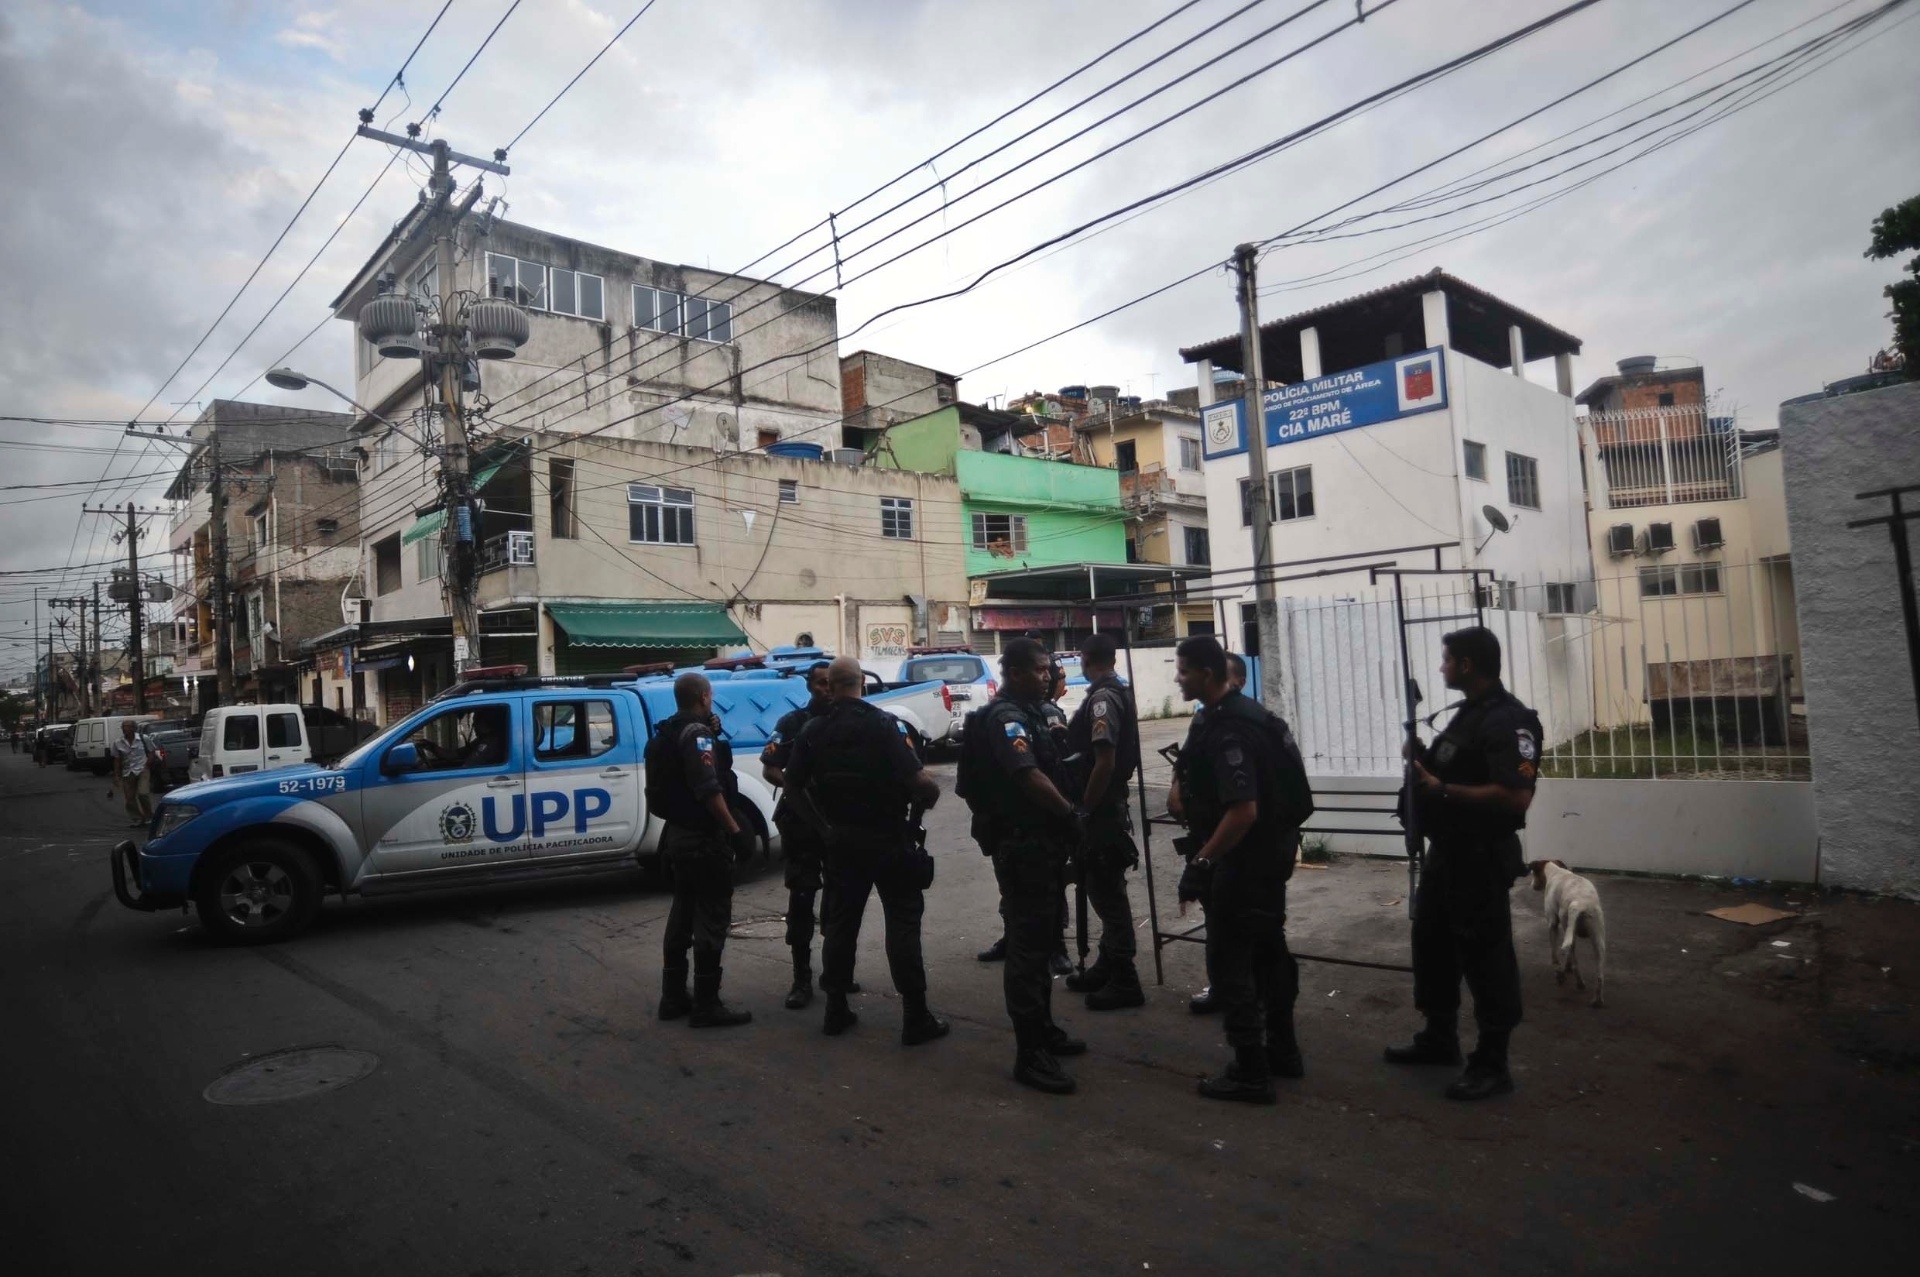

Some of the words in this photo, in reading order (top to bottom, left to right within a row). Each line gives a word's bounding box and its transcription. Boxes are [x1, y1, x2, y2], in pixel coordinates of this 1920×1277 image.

[1263, 385, 1309, 403] POLÍCIA
[1312, 371, 1364, 392] MILITAR
[1283, 400, 1291, 408] DE
[1341, 386, 1353, 394] DE
[1354, 379, 1381, 391] ÁREA
[1312, 400, 1340, 416] BPM
[1278, 422, 1304, 438] CIA
[1307, 407, 1352, 433] MARÉ
[870, 627, 905, 646] SVS
[279, 776, 346, 793] 52-1979
[481, 787, 612, 843] UPP
[441, 848, 486, 860] UNIDADE
[488, 846, 503, 855] DE
[504, 842, 543, 853] POLÍCIA
[546, 835, 613, 849] PACIFICADORA
